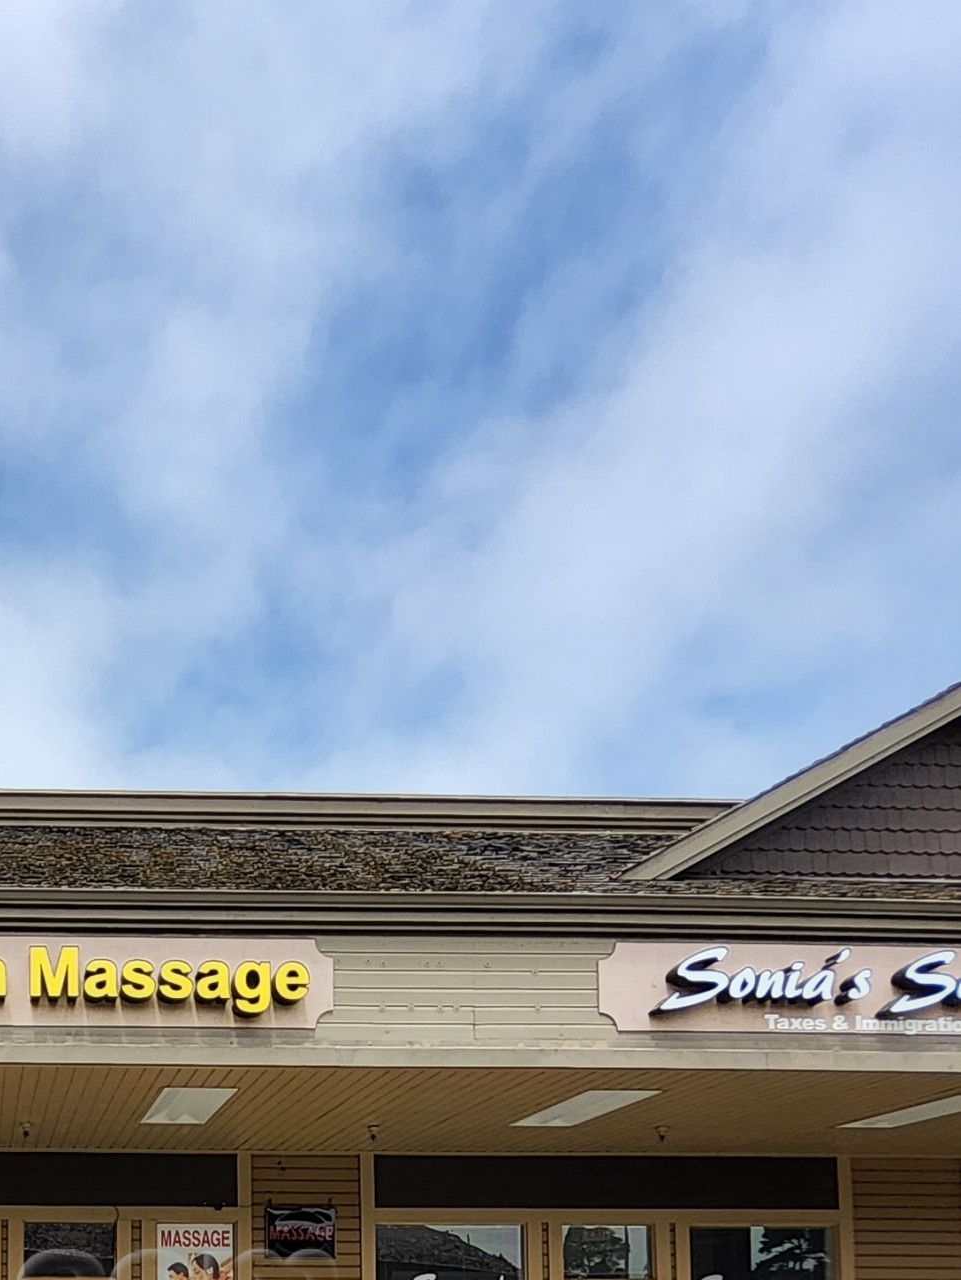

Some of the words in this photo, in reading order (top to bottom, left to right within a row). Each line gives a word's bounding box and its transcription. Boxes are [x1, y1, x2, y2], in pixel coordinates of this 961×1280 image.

[29, 945, 310, 1014] Massage
[652, 946, 873, 1013] Sonia's
[883, 950, 961, 1014] S
[764, 1014, 826, 1031] Taxes
[831, 1015, 849, 1031] &
[161, 1230, 230, 1247] MASSAGE
[269, 1225, 334, 1241] MASSAGE
